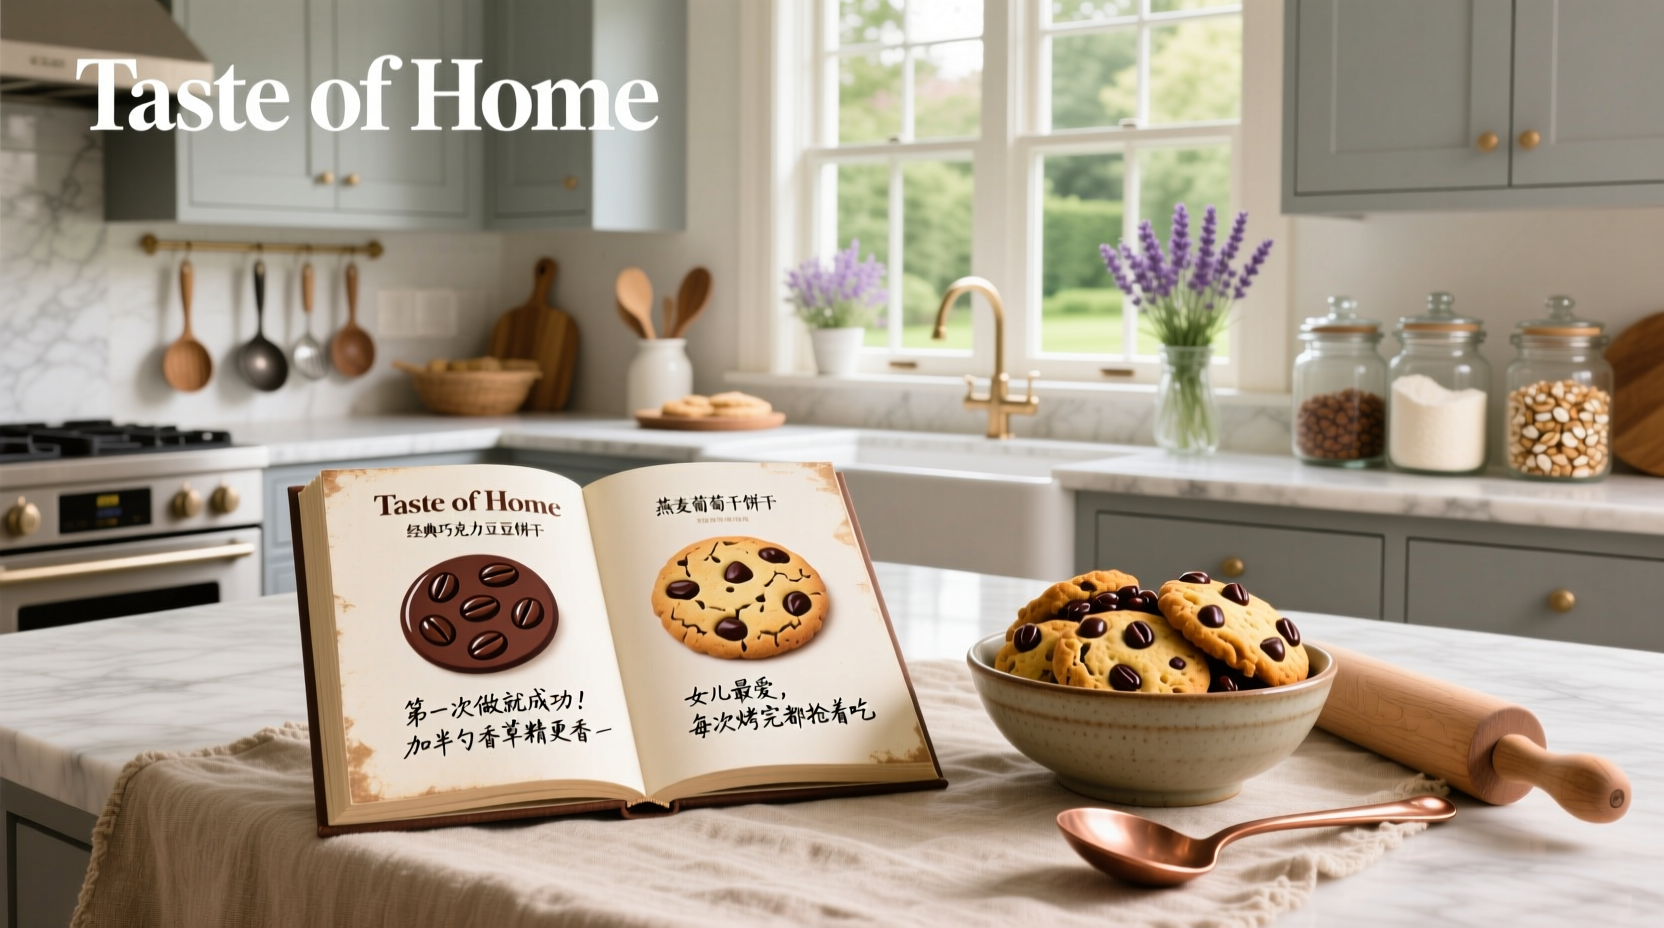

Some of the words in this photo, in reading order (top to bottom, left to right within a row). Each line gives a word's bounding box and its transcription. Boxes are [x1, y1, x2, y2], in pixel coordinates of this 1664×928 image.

[373, 494, 445, 517] Taste
[451, 489, 482, 512] of
[484, 490, 562, 517] Home
[406, 521, 544, 538] 经典巧克力豆豆饼干
[684, 676, 787, 707] 女儿最爱，
[404, 688, 585, 728] 第一次做就成功！
[689, 698, 877, 739] 每次烤完都抢着吃
